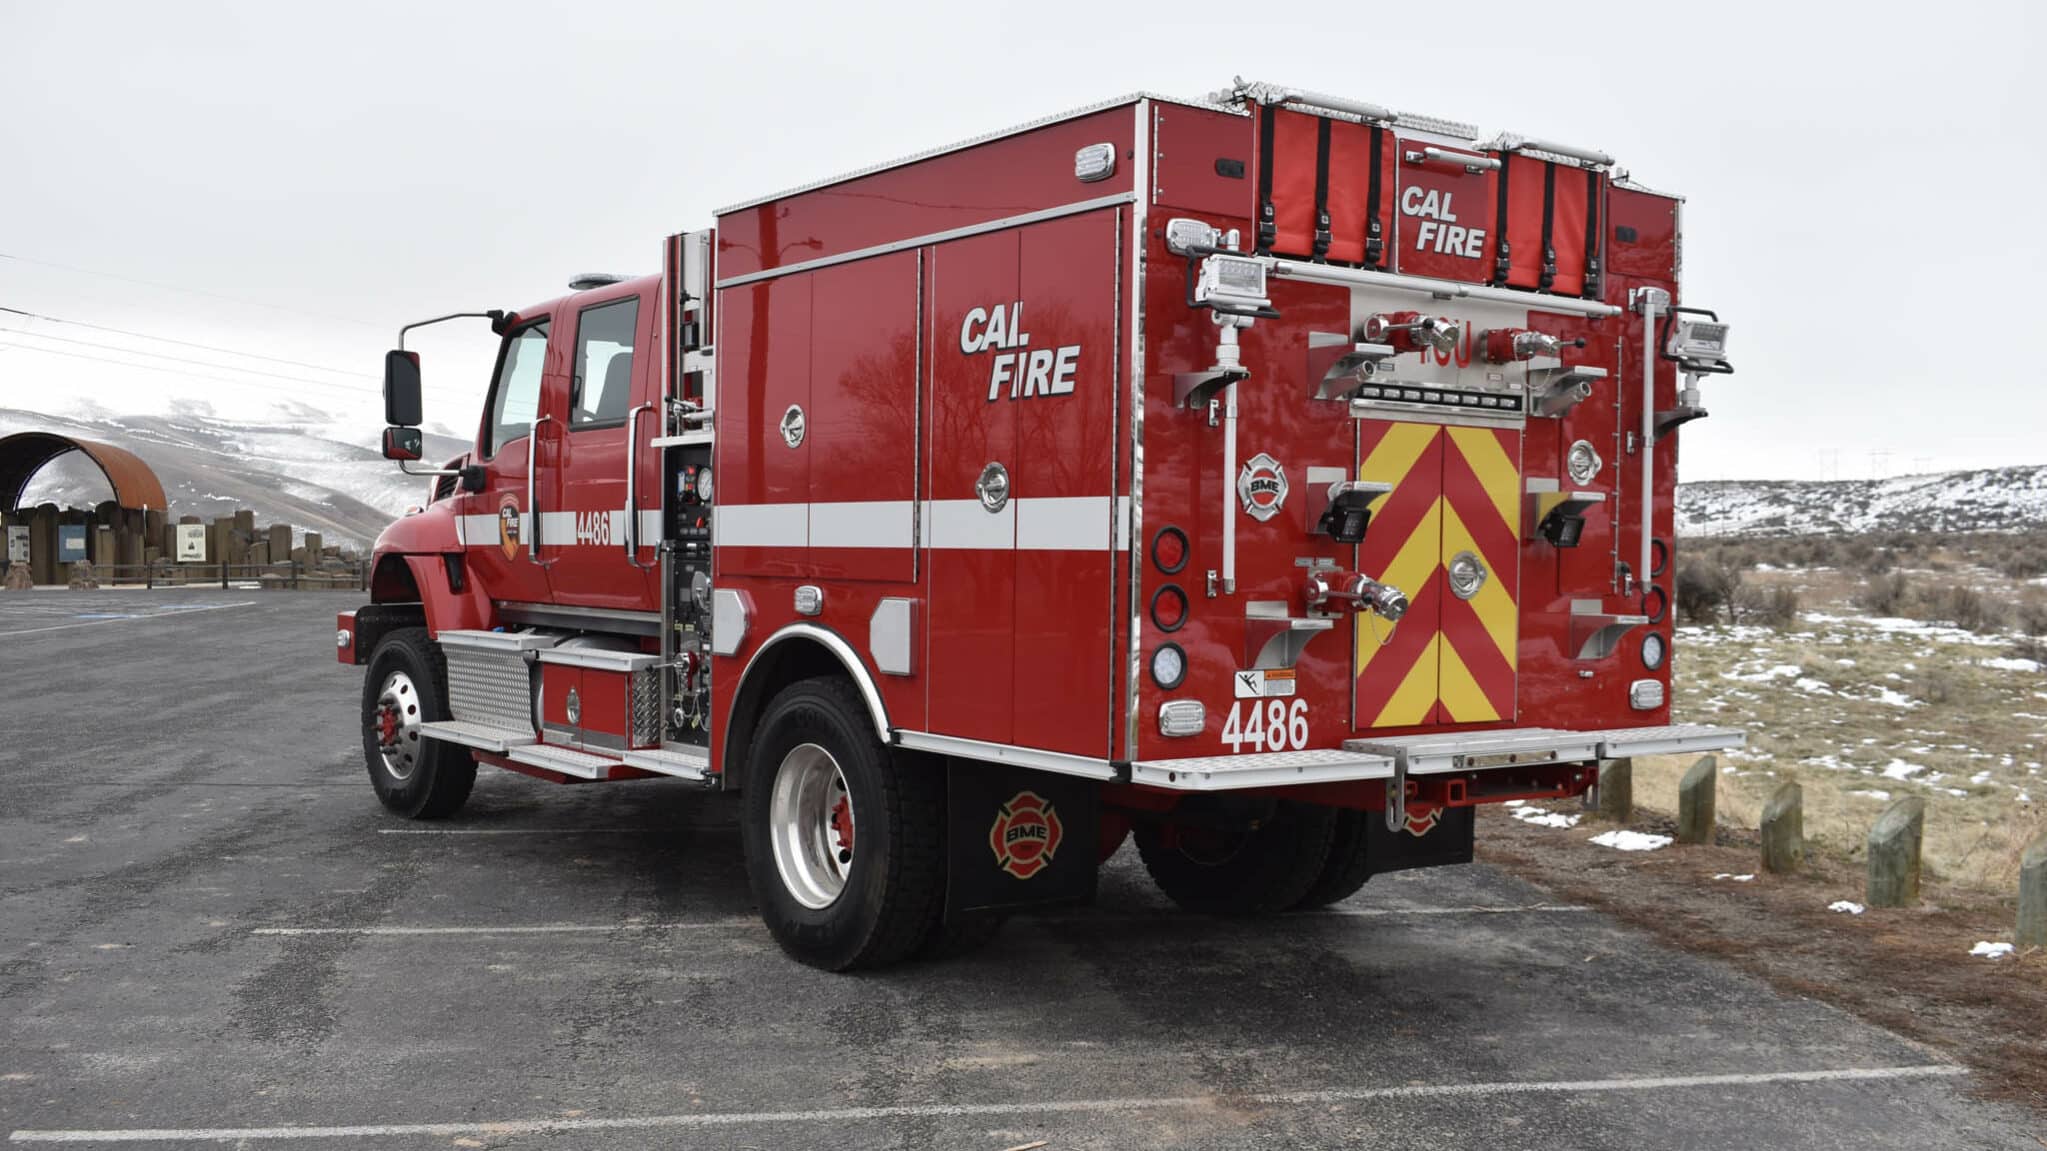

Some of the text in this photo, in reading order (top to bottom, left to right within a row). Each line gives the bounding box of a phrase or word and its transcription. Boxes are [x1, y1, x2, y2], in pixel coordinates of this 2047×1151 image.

[1401, 185, 1457, 223] CAL
[1416, 221, 1486, 259] FIRE
[960, 300, 1030, 355] CAL
[987, 345, 1081, 402] FIRE
[1250, 479, 1279, 493] BME
[577, 511, 609, 546] 4486
[1221, 698, 1309, 754] 4486
[1006, 824, 1048, 843] BME
